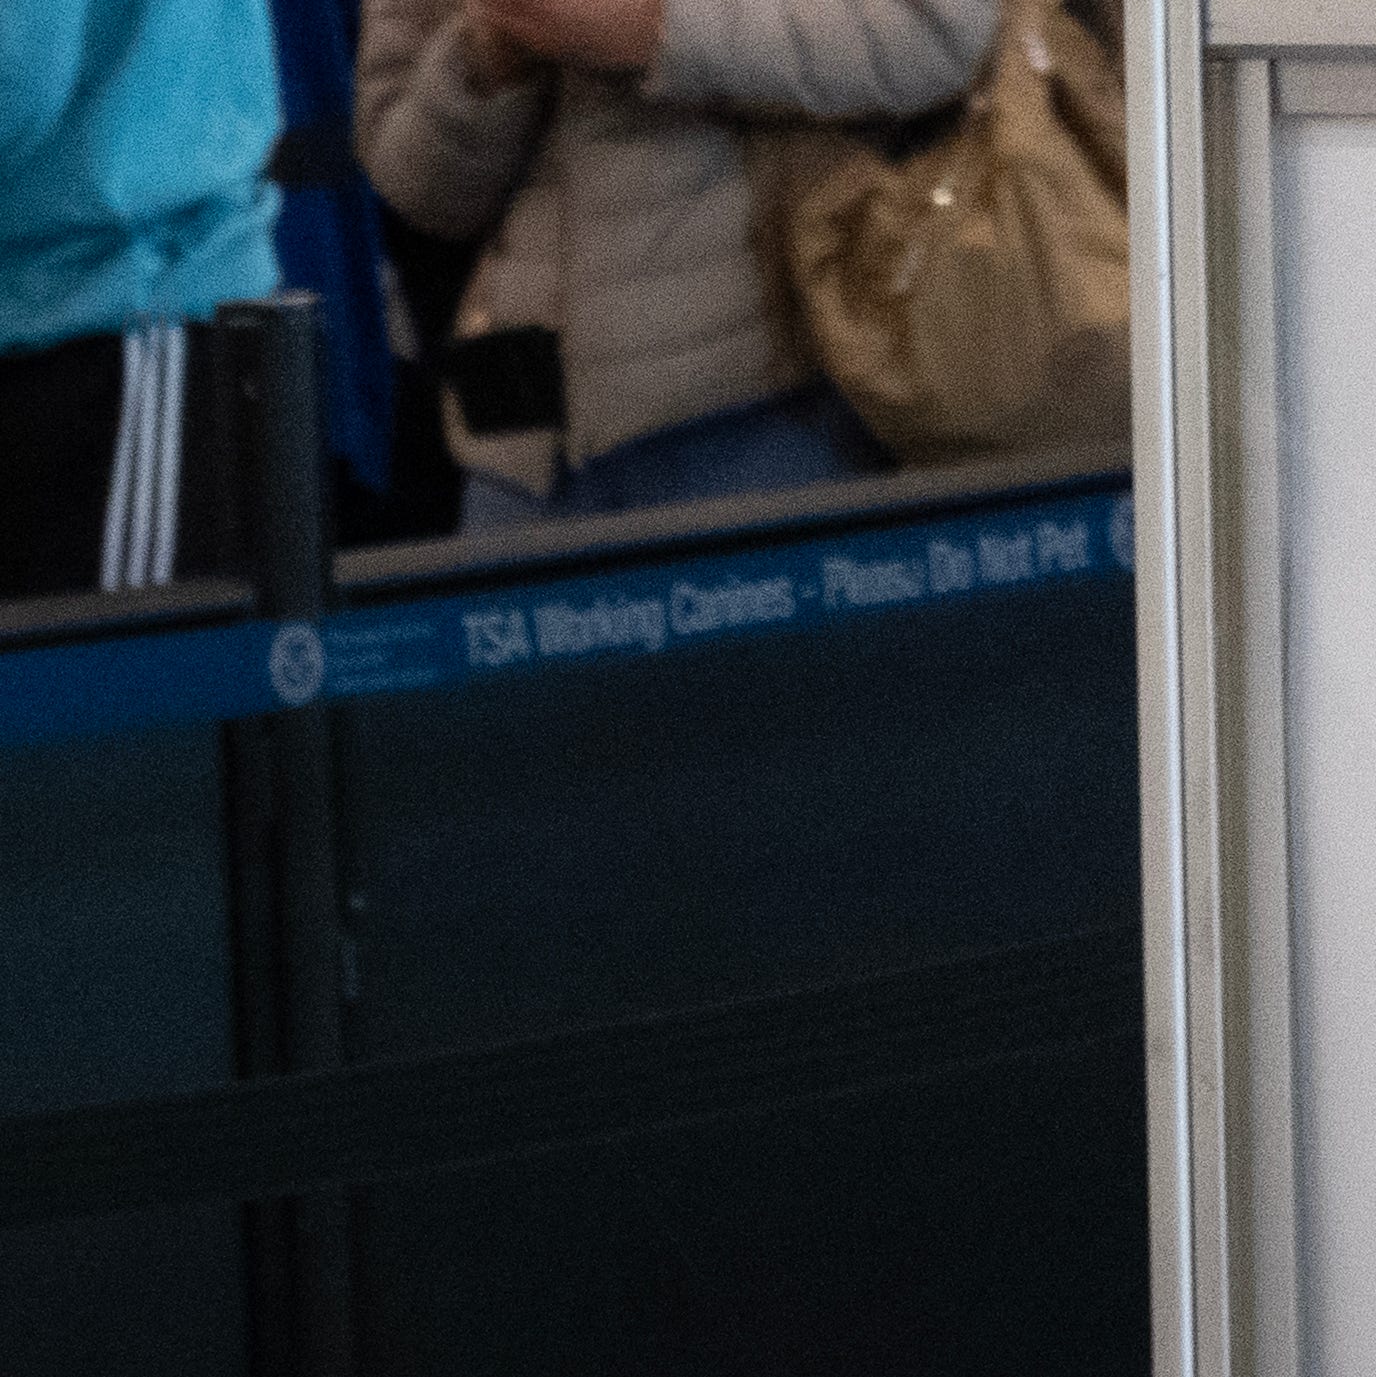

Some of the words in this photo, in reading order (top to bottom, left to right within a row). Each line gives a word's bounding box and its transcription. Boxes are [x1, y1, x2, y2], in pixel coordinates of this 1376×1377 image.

[462, 608, 532, 668] TSA
[534, 598, 666, 658] Working
[669, 574, 797, 636] Canines
[927, 539, 976, 593] Do
[1037, 521, 1091, 574] Pet
